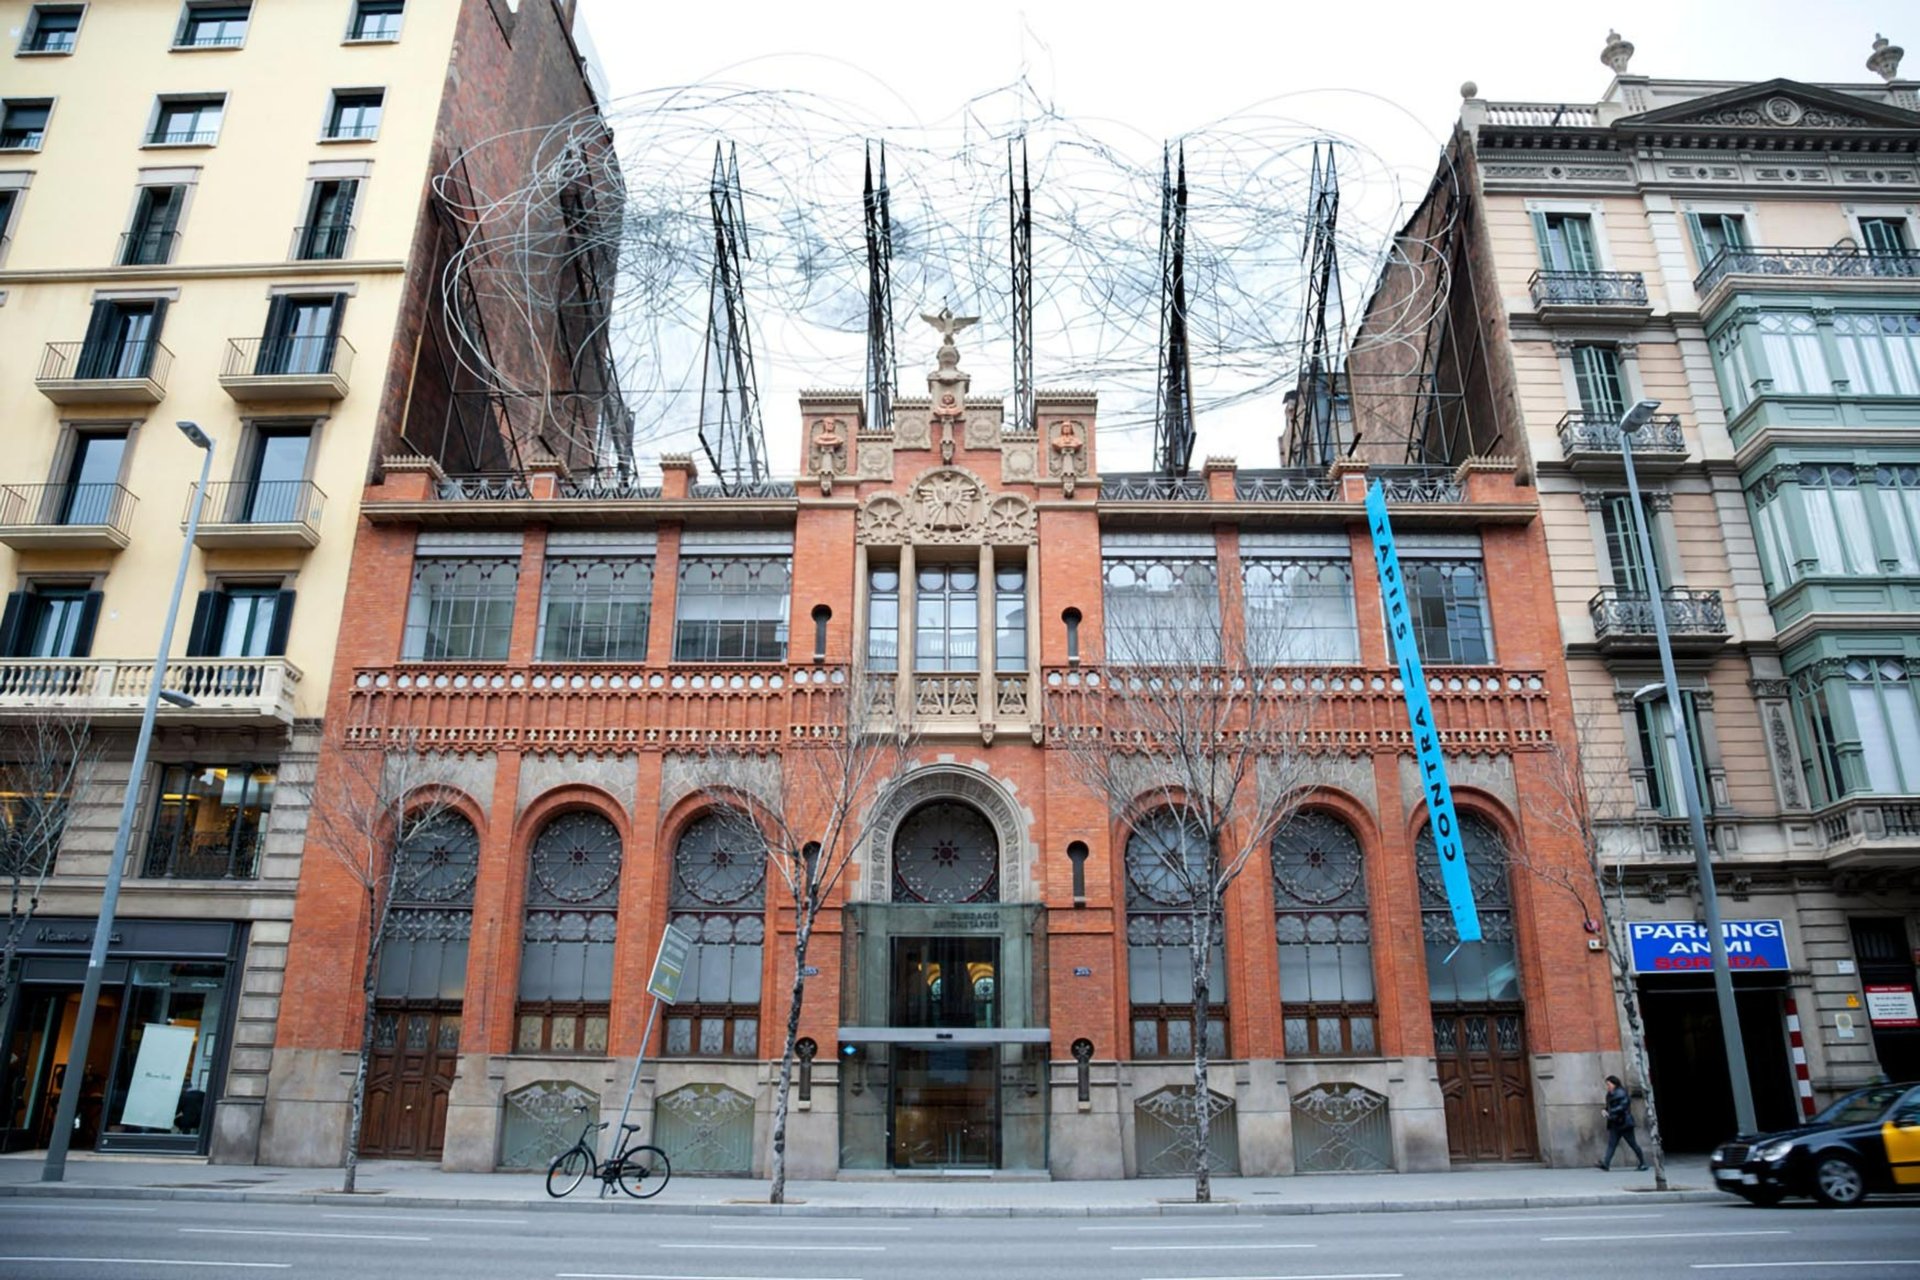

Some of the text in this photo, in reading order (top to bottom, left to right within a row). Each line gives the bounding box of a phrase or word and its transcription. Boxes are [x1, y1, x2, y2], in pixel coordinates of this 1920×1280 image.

[1376, 517, 1407, 640] TÀPIES
[1415, 706, 1456, 862] CONTRA
[1654, 955, 1770, 970] SORIDA
